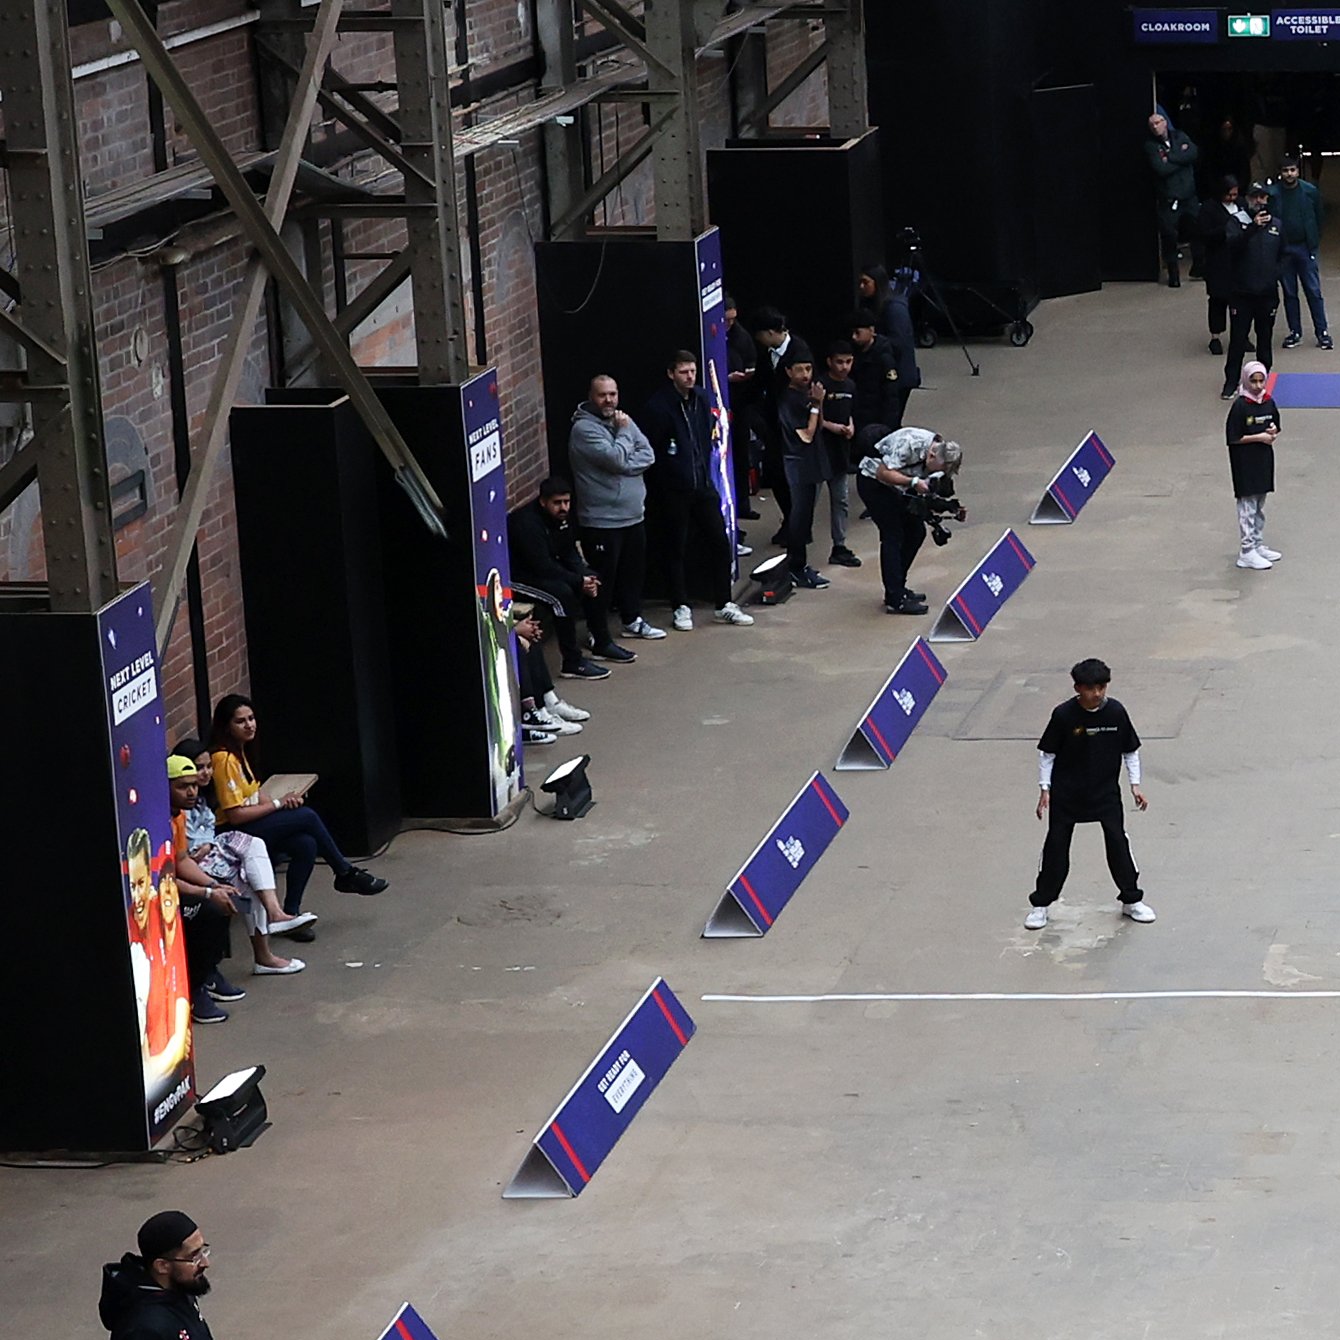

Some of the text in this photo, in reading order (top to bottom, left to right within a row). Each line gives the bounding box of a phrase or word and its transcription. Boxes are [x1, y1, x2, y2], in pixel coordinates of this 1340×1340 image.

[1141, 23, 1210, 32] CLOAKROOM
[1290, 25, 1329, 34] TOILET
[469, 418, 499, 445] NEXT LEVEL
[475, 442, 497, 471] FANS
[110, 650, 154, 691] NEXT LEVEL
[117, 678, 152, 714] CRICKET
[597, 1050, 630, 1093] GET READY FOR
